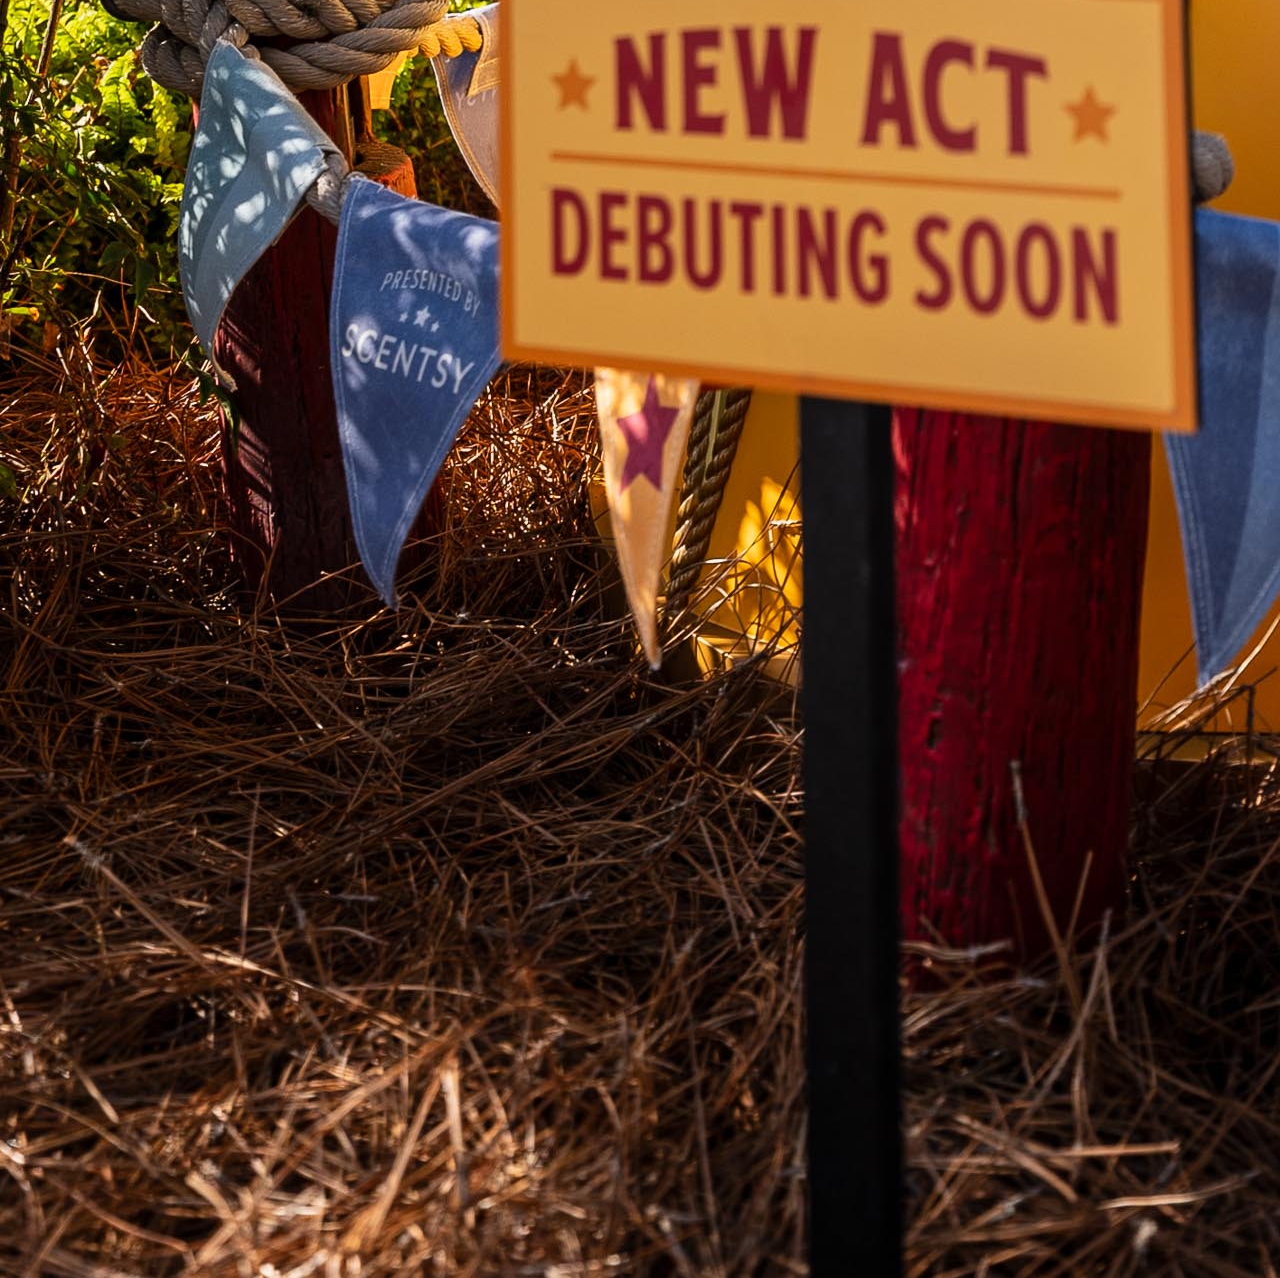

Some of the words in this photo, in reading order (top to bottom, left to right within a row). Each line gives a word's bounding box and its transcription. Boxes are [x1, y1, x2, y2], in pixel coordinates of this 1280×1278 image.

[613, 25, 819, 141] NEW
[860, 30, 1049, 156] ACT
[379, 268, 462, 302] PRESENTED
[463, 290, 481, 318] BY
[549, 187, 890, 306] DEBUTING
[913, 214, 1119, 328] SOON
[341, 323, 475, 395] SCENTSY
